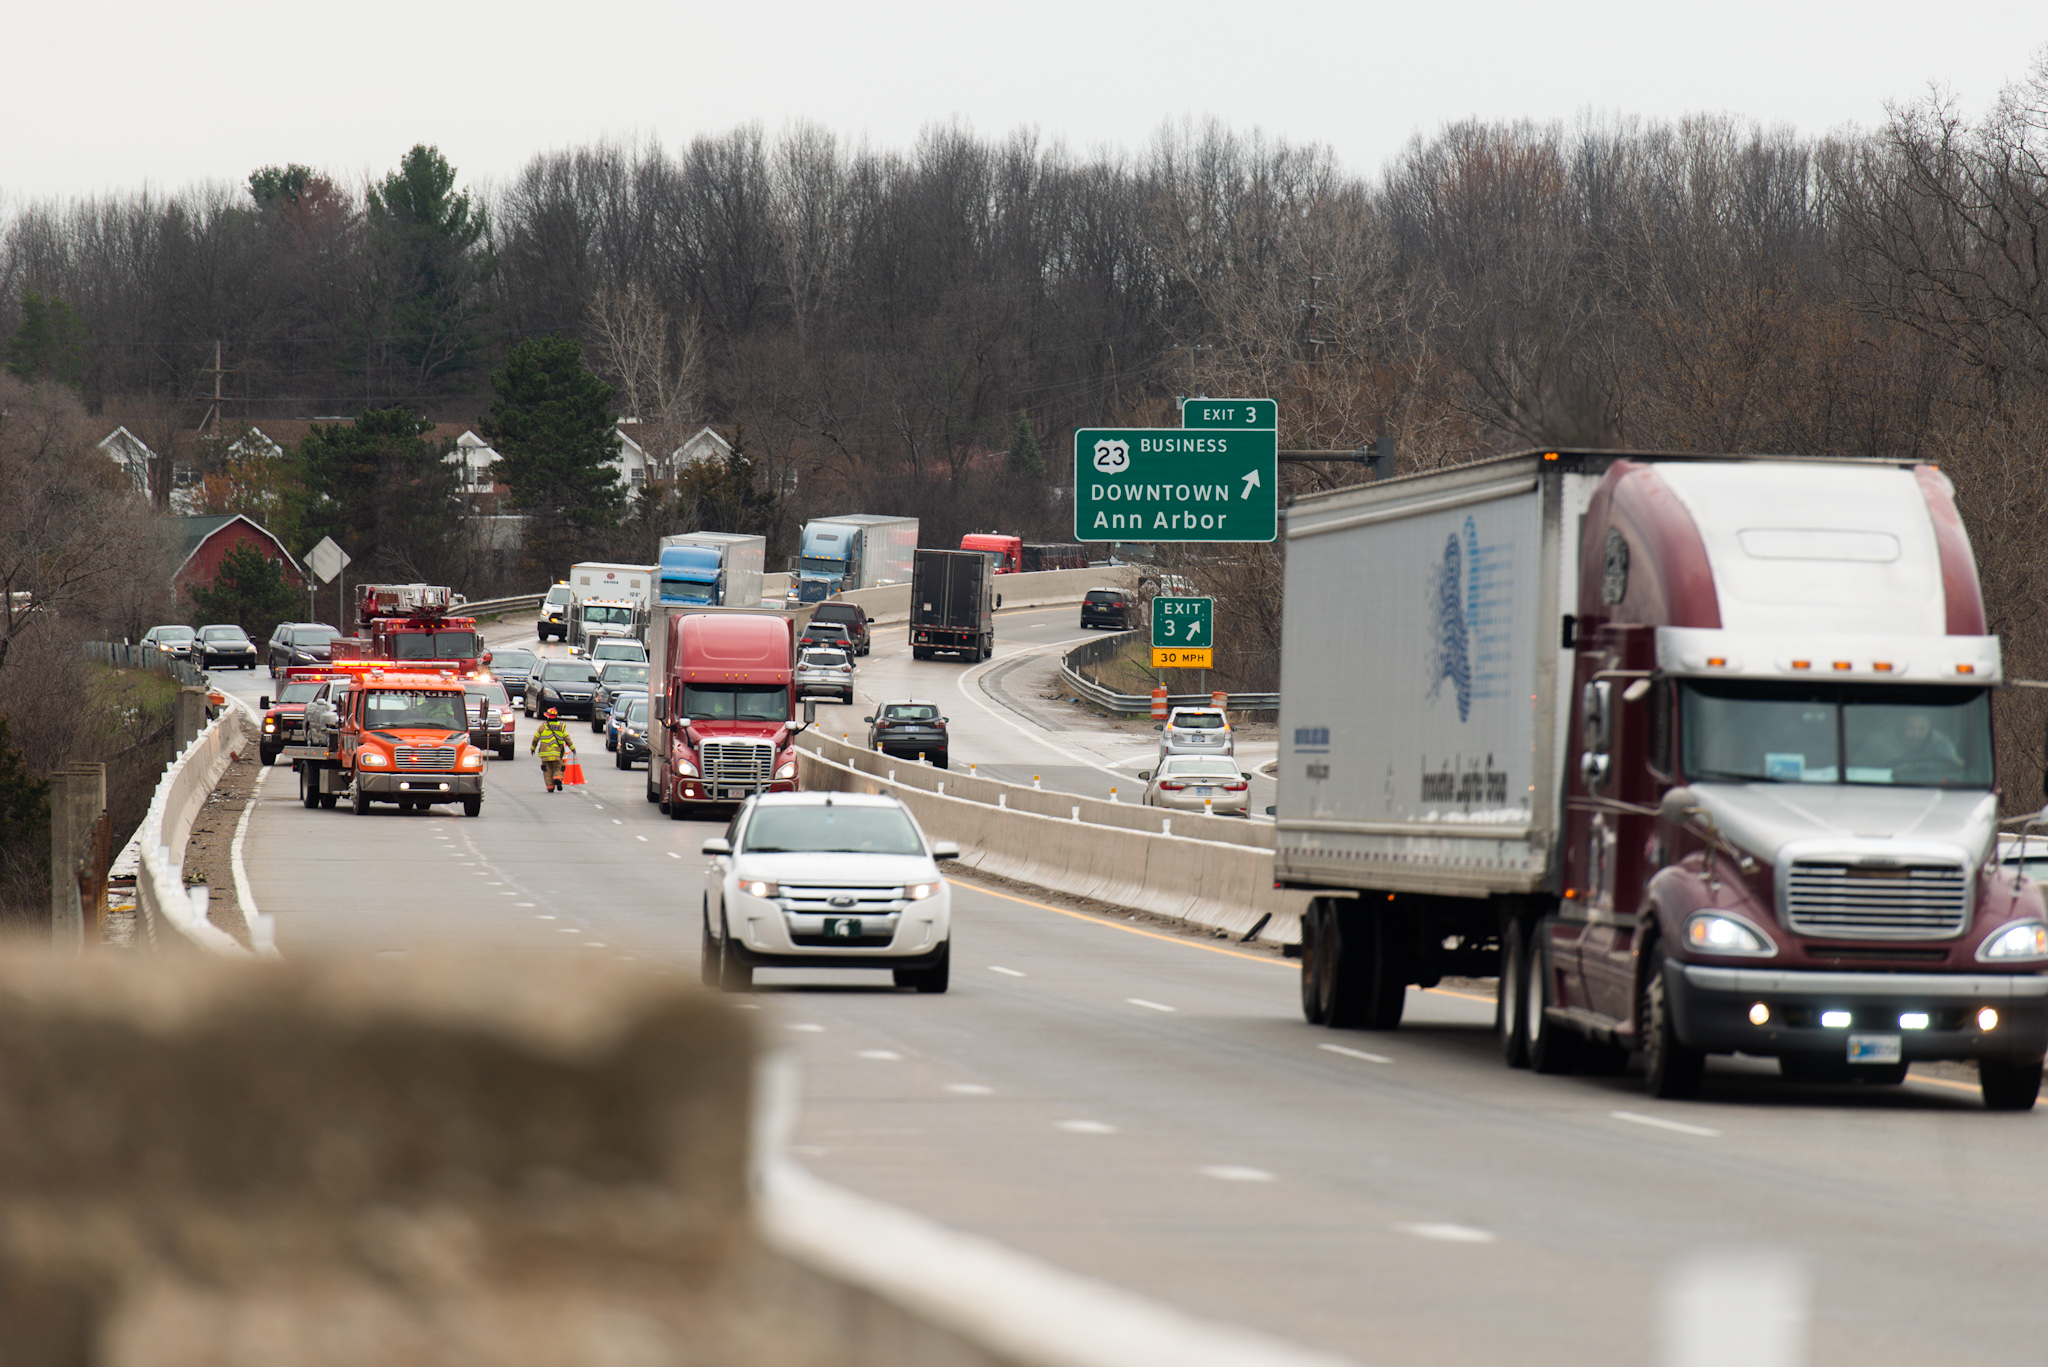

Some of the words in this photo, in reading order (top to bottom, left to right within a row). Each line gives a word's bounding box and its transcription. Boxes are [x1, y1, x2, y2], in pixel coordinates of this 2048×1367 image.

[1203, 408, 1235, 421] EXIT
[1245, 406, 1257, 424] 3
[1140, 438, 1228, 453] BUSINESS
[1097, 446, 1125, 466] 23
[1091, 484, 1229, 501] DOWNTOWN
[1093, 511, 1143, 529] Ann
[1153, 510, 1227, 530] Arbor
[1164, 602, 1201, 615] EXIT
[1164, 619, 1176, 637] 3
[1160, 653, 1177, 663] 30
[1182, 654, 1204, 662] MPH
[371, 689, 459, 698] TRIANGLE
